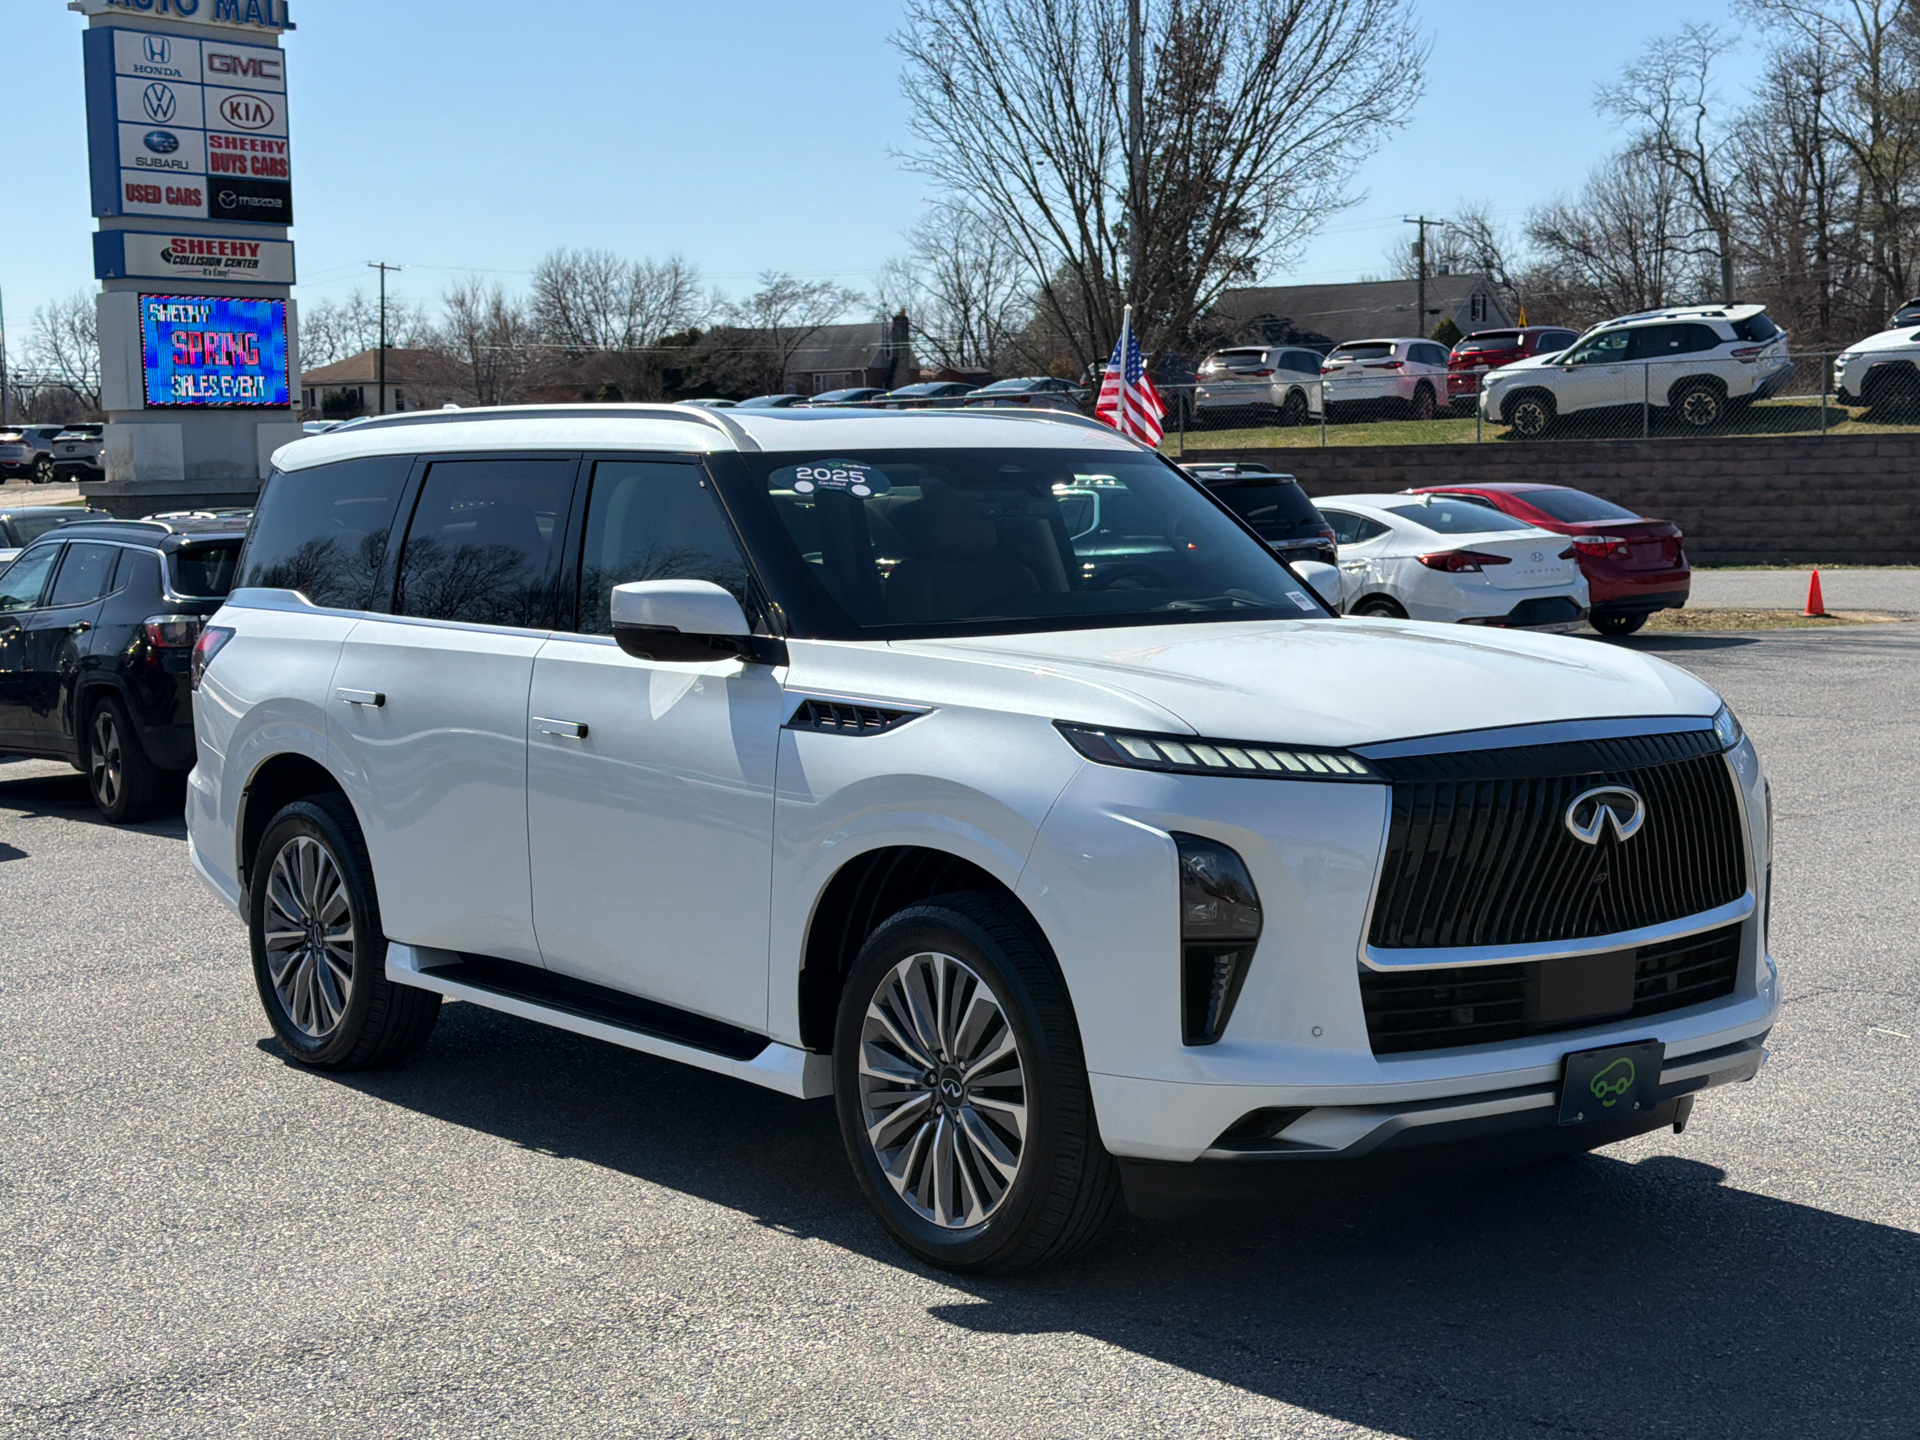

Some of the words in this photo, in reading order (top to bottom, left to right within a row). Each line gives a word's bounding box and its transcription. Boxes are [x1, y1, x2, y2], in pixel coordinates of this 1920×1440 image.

[214, 0, 296, 30] MALL
[132, 64, 183, 78] HONDA
[208, 53, 281, 81] GMC
[229, 102, 266, 123] KIA
[209, 134, 287, 154] SHEEHY
[135, 156, 189, 170] SUBARU
[210, 152, 247, 175] BUYS
[251, 156, 287, 178] CARS
[125, 183, 162, 205] USED
[166, 186, 202, 207] CARS
[238, 196, 283, 208] mazda
[170, 238, 260, 257] SHEEHY
[172, 255, 221, 267] COLLISION
[223, 257, 260, 269] CENTER
[202, 267, 212, 277] It's
[172, 331, 260, 366] SPRING
[171, 375, 220, 397] SALES
[796, 467, 866, 483] 2025
